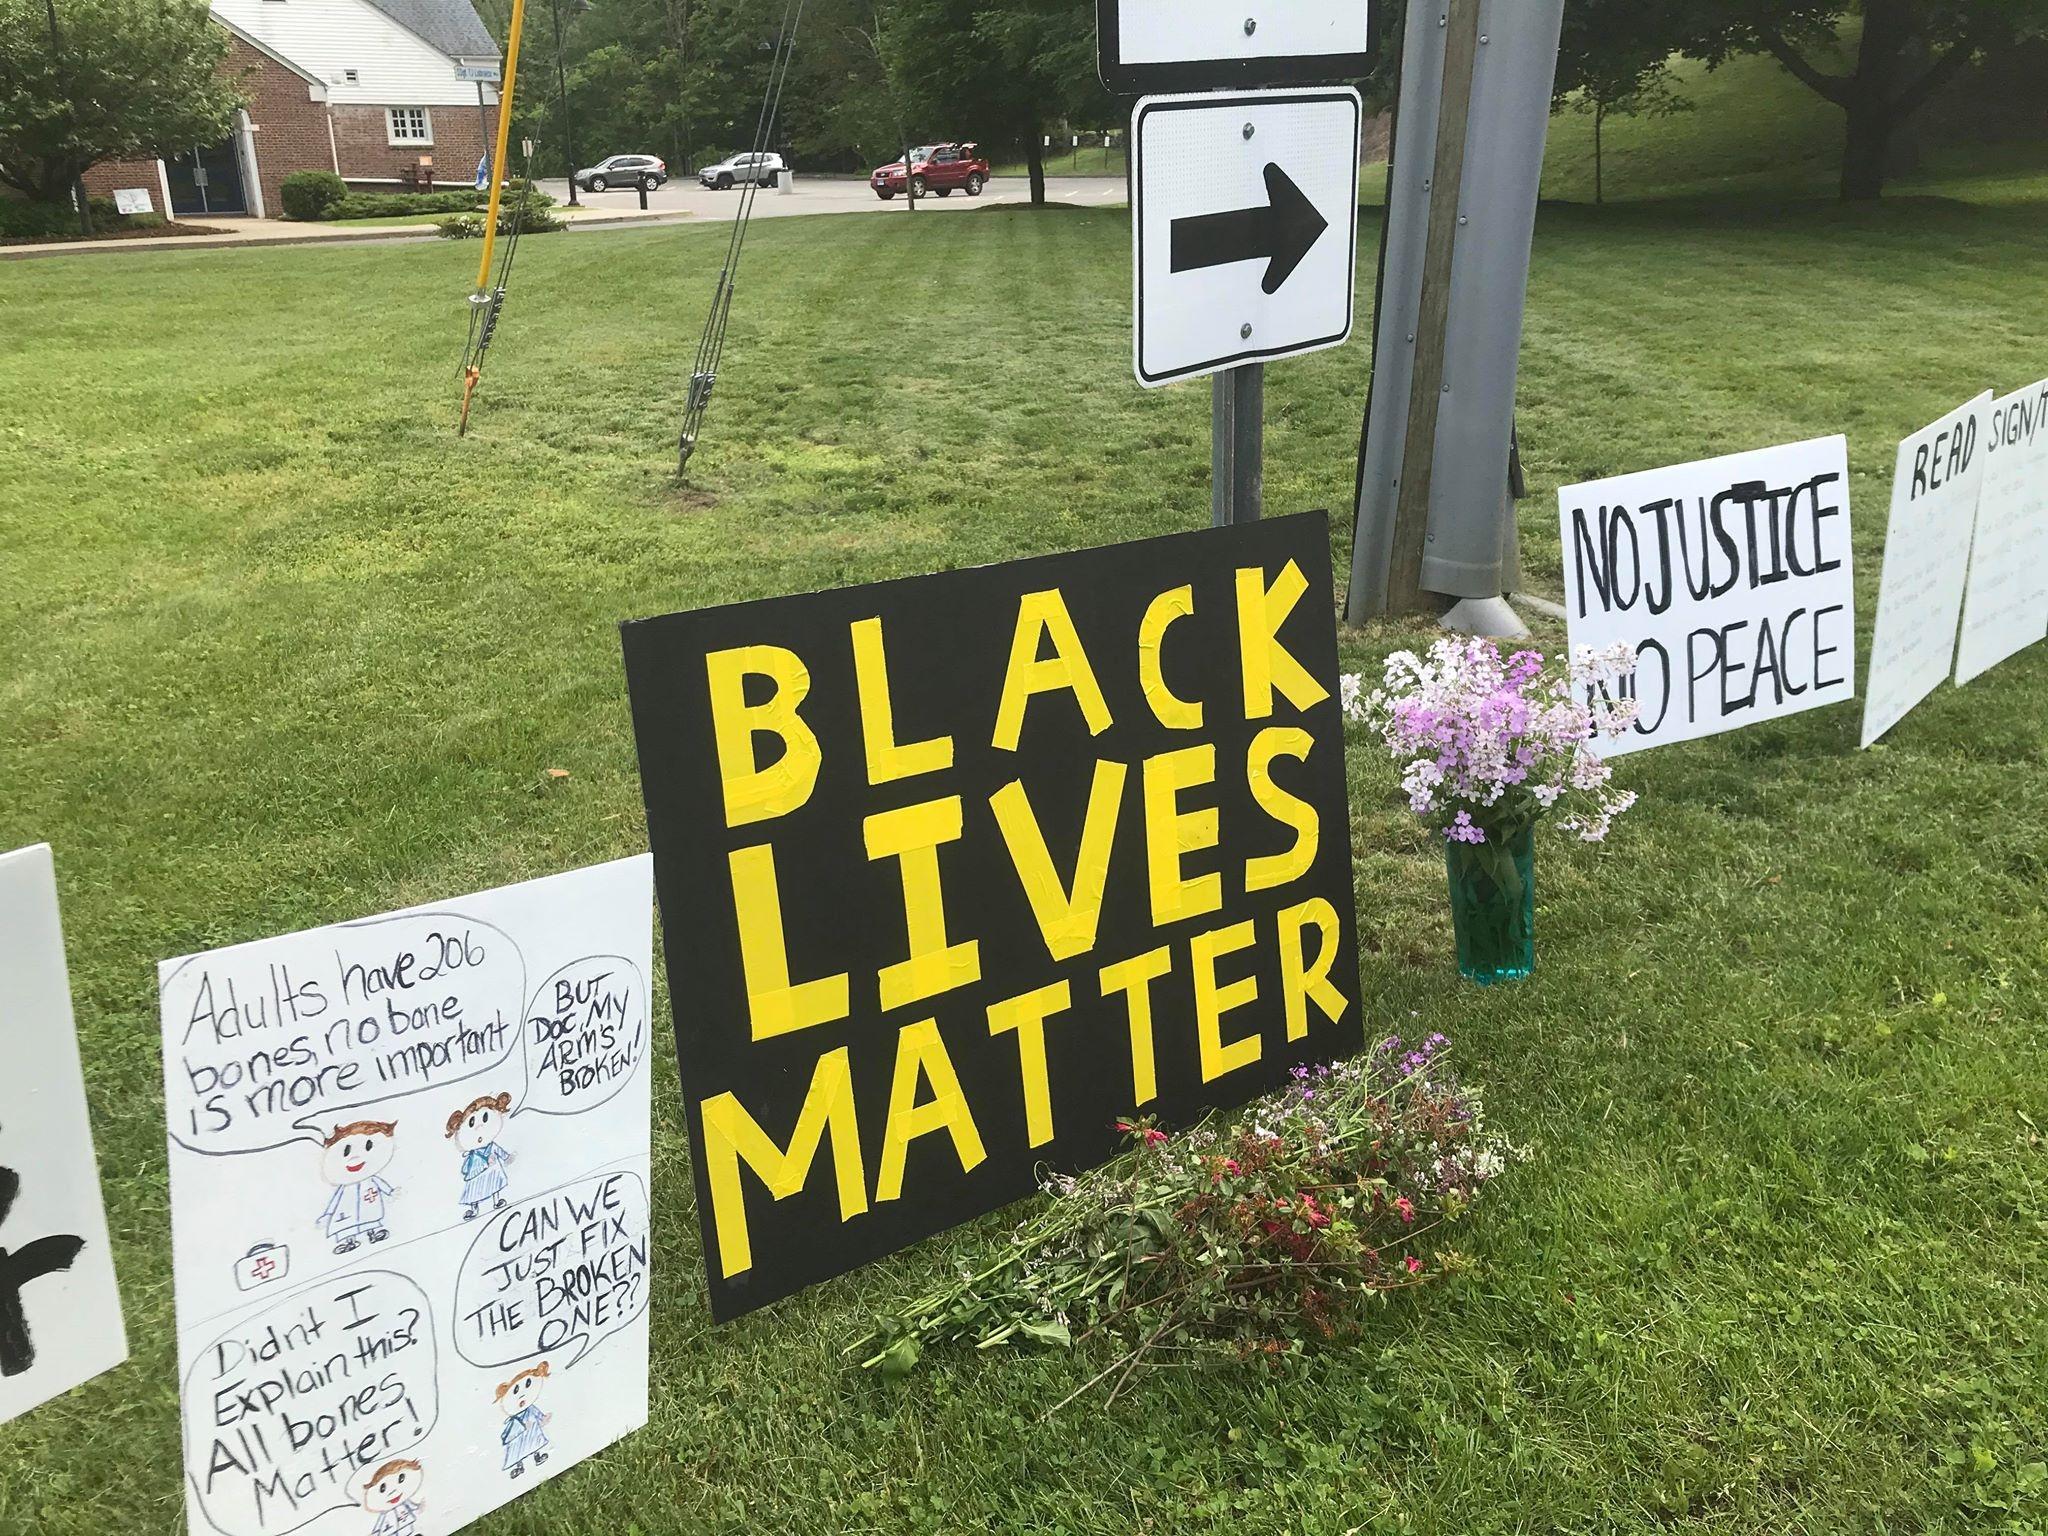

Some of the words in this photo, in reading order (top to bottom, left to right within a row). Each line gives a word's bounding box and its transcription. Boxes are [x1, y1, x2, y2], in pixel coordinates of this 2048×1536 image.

[1911, 414, 1977, 501] READ
[1572, 505, 1641, 618] NO
[1639, 472, 1841, 616] JUSTICE
[706, 558, 1331, 828] BLACK
[1687, 604, 1844, 723] PEACE
[728, 726, 1320, 1042] LIVES
[182, 963, 328, 1046] Adults
[334, 949, 415, 1005] have
[418, 929, 485, 981] 206
[555, 971, 615, 1015] BUT
[585, 985, 630, 1032] MY
[183, 1034, 319, 1096] bones,
[324, 1018, 381, 1056] no
[386, 996, 463, 1036] bone
[190, 1094, 232, 1136] is
[244, 1060, 364, 1119] more
[375, 1008, 511, 1083] important
[559, 1018, 642, 1097] BROKEN!
[700, 897, 1349, 1280] MATTER
[481, 1232, 574, 1293] JUST
[580, 1208, 630, 1256] FIX
[499, 1198, 559, 1252] CAN
[564, 1174, 624, 1226] WE
[333, 1284, 380, 1331] I
[463, 1298, 525, 1338] THE
[534, 1233, 647, 1319] BROKEN
[537, 1272, 642, 1351] ONE??
[214, 1353, 351, 1427] Explain
[353, 1307, 420, 1369] this?
[206, 1423, 272, 1495] All
[281, 1372, 406, 1451] bones
[252, 1397, 424, 1528] Matter!
